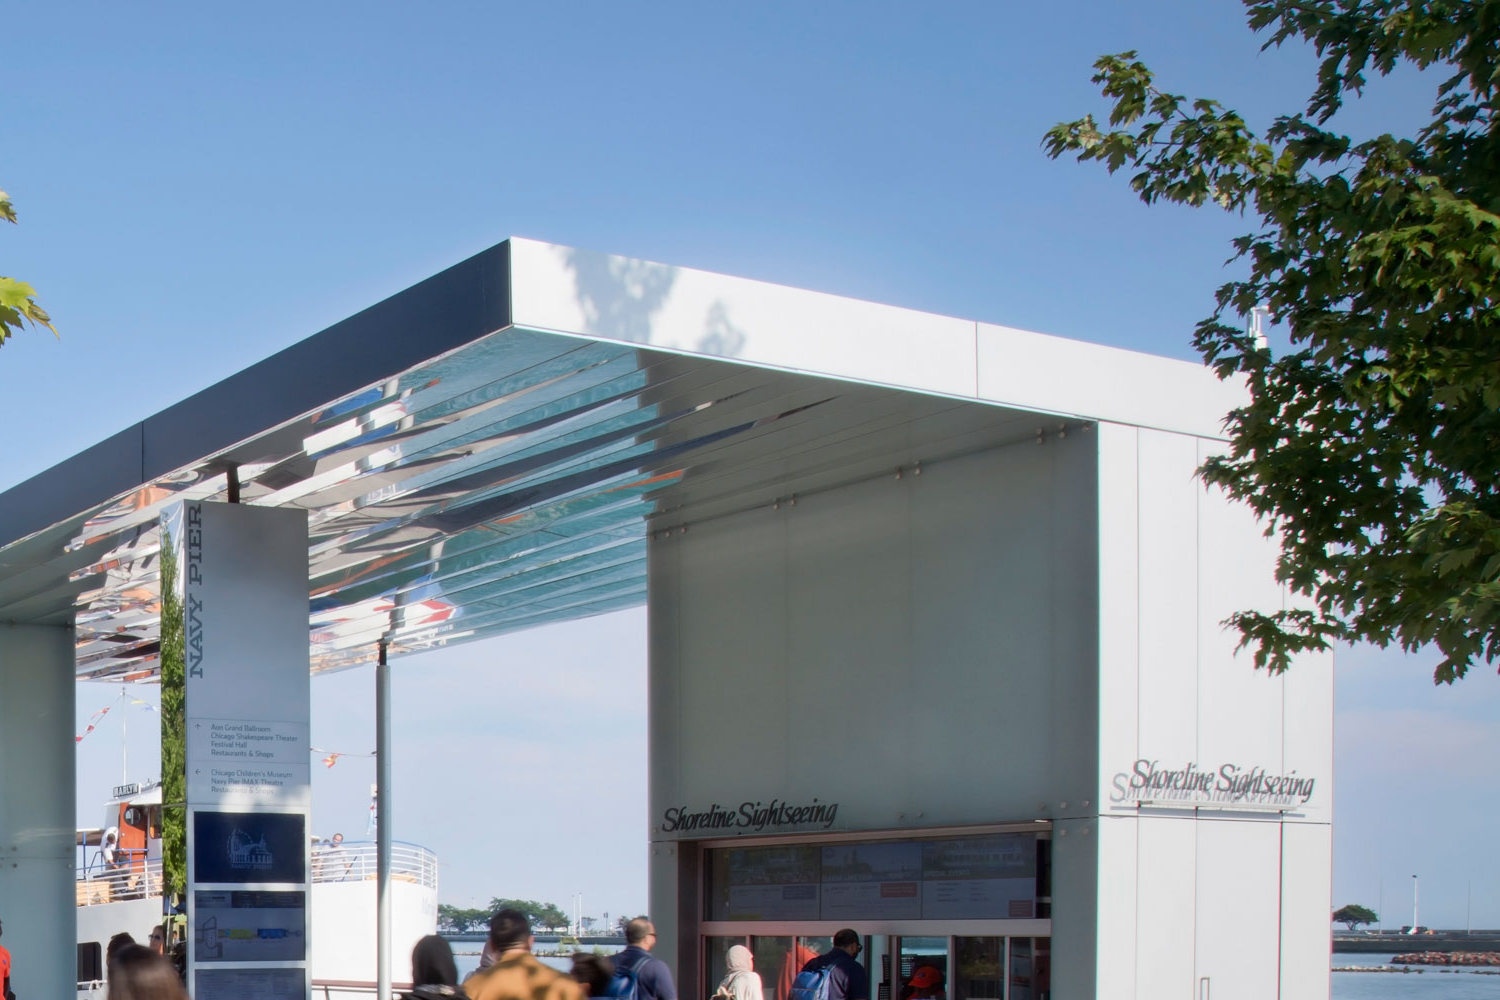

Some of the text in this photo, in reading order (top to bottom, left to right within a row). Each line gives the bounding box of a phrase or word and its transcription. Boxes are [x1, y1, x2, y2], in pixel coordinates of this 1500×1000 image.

[188, 503, 203, 679] NAVY PIER
[244, 724, 271, 732] Ballroom
[211, 732, 235, 740] Chicago
[236, 733, 274, 741] Shakespeare
[211, 749, 247, 757] Restaurants
[255, 750, 274, 758] Shops
[211, 769, 293, 778] Chicago Children's Museum
[1129, 759, 1315, 804] Shoreline Sightseeing
[661, 798, 839, 832] Shoreline Sightseeing
